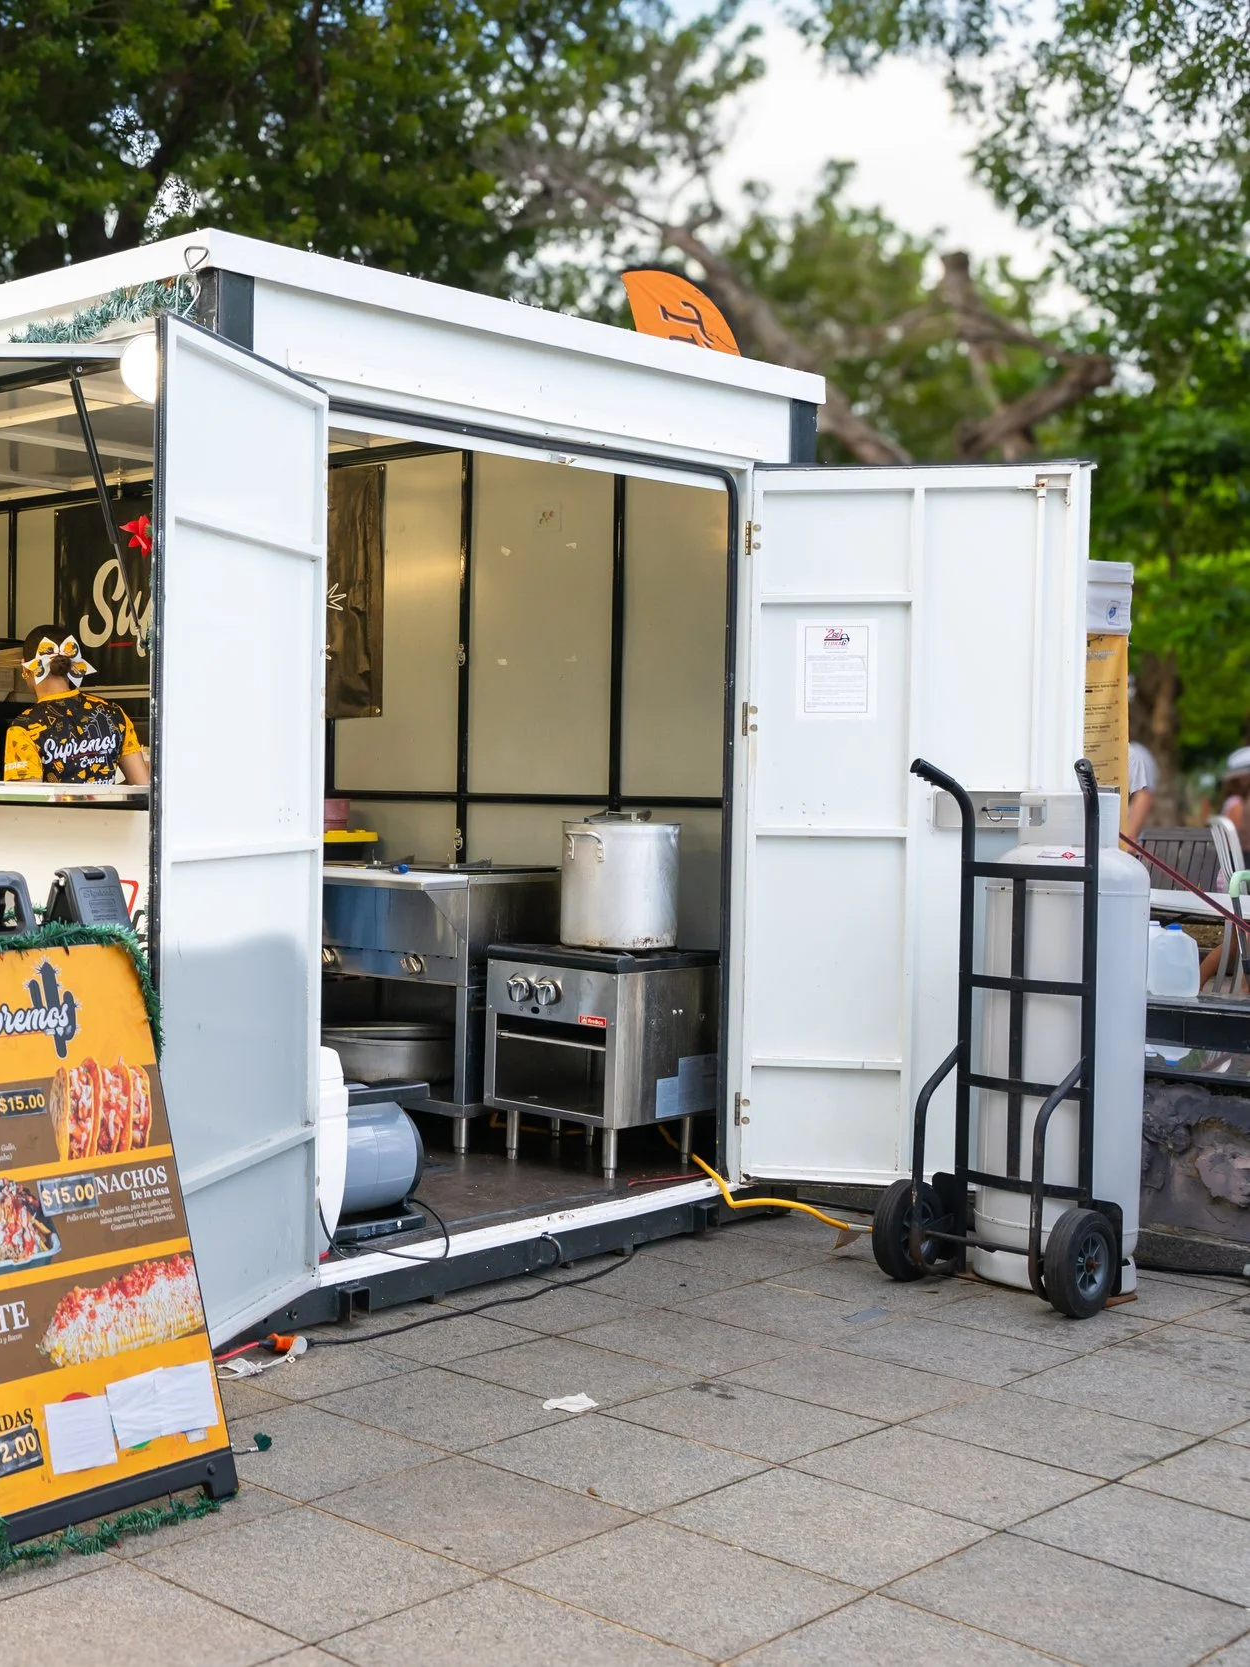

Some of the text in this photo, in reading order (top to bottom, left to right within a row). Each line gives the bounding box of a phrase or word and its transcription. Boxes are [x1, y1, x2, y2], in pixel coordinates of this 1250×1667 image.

[43, 734, 116, 764] Supremos
[95, 1165, 168, 1195] NACHOS
[131, 1186, 170, 1201] De la casa
[41, 1183, 95, 1209] $15.00
